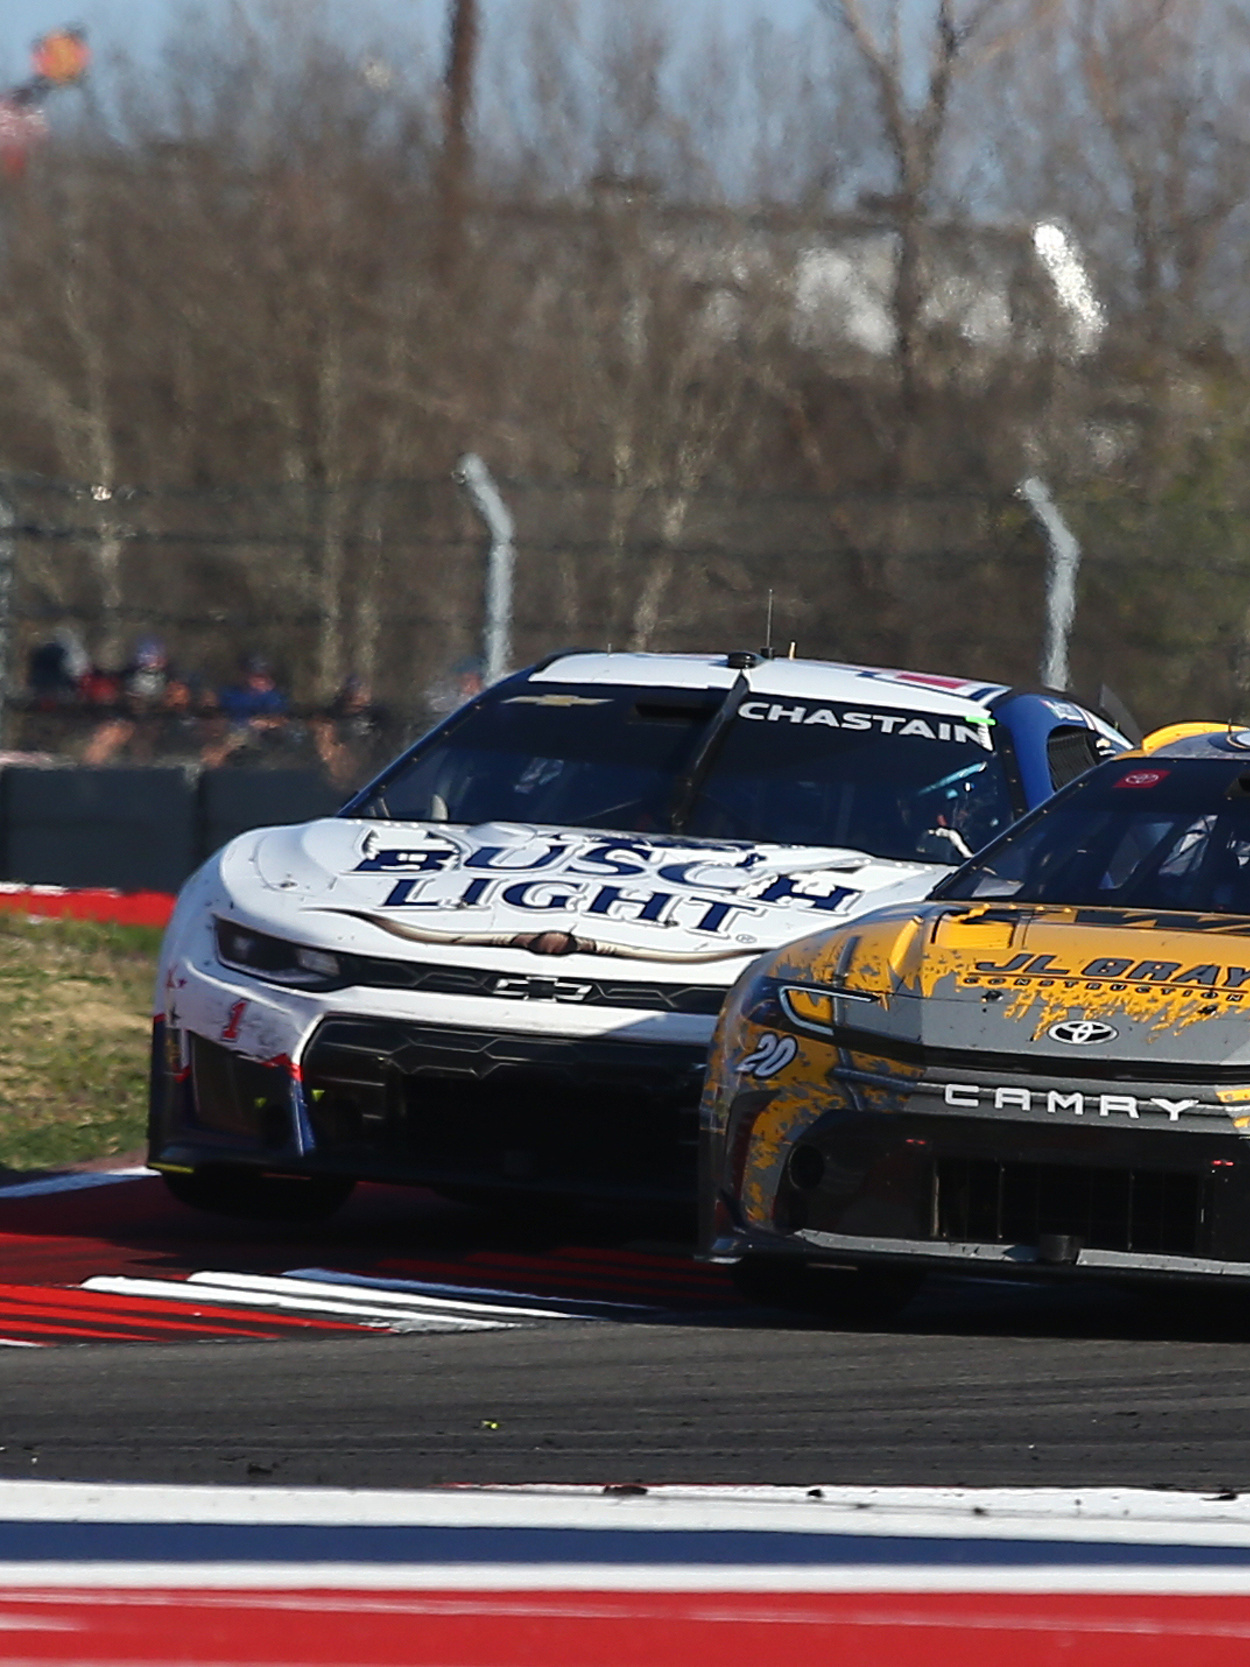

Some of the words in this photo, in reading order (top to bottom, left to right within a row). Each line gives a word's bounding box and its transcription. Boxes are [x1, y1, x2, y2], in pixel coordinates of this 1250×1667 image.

[738, 702, 992, 750] CHASTAIN
[350, 826, 865, 915] BUSCH
[381, 877, 764, 938] LIGHT
[975, 953, 1069, 975] JL
[963, 976, 1246, 1002] CONSTRUCTION
[220, 999, 250, 1042] 1
[736, 1032, 798, 1079] 20
[945, 1083, 1200, 1122] CAMRY
